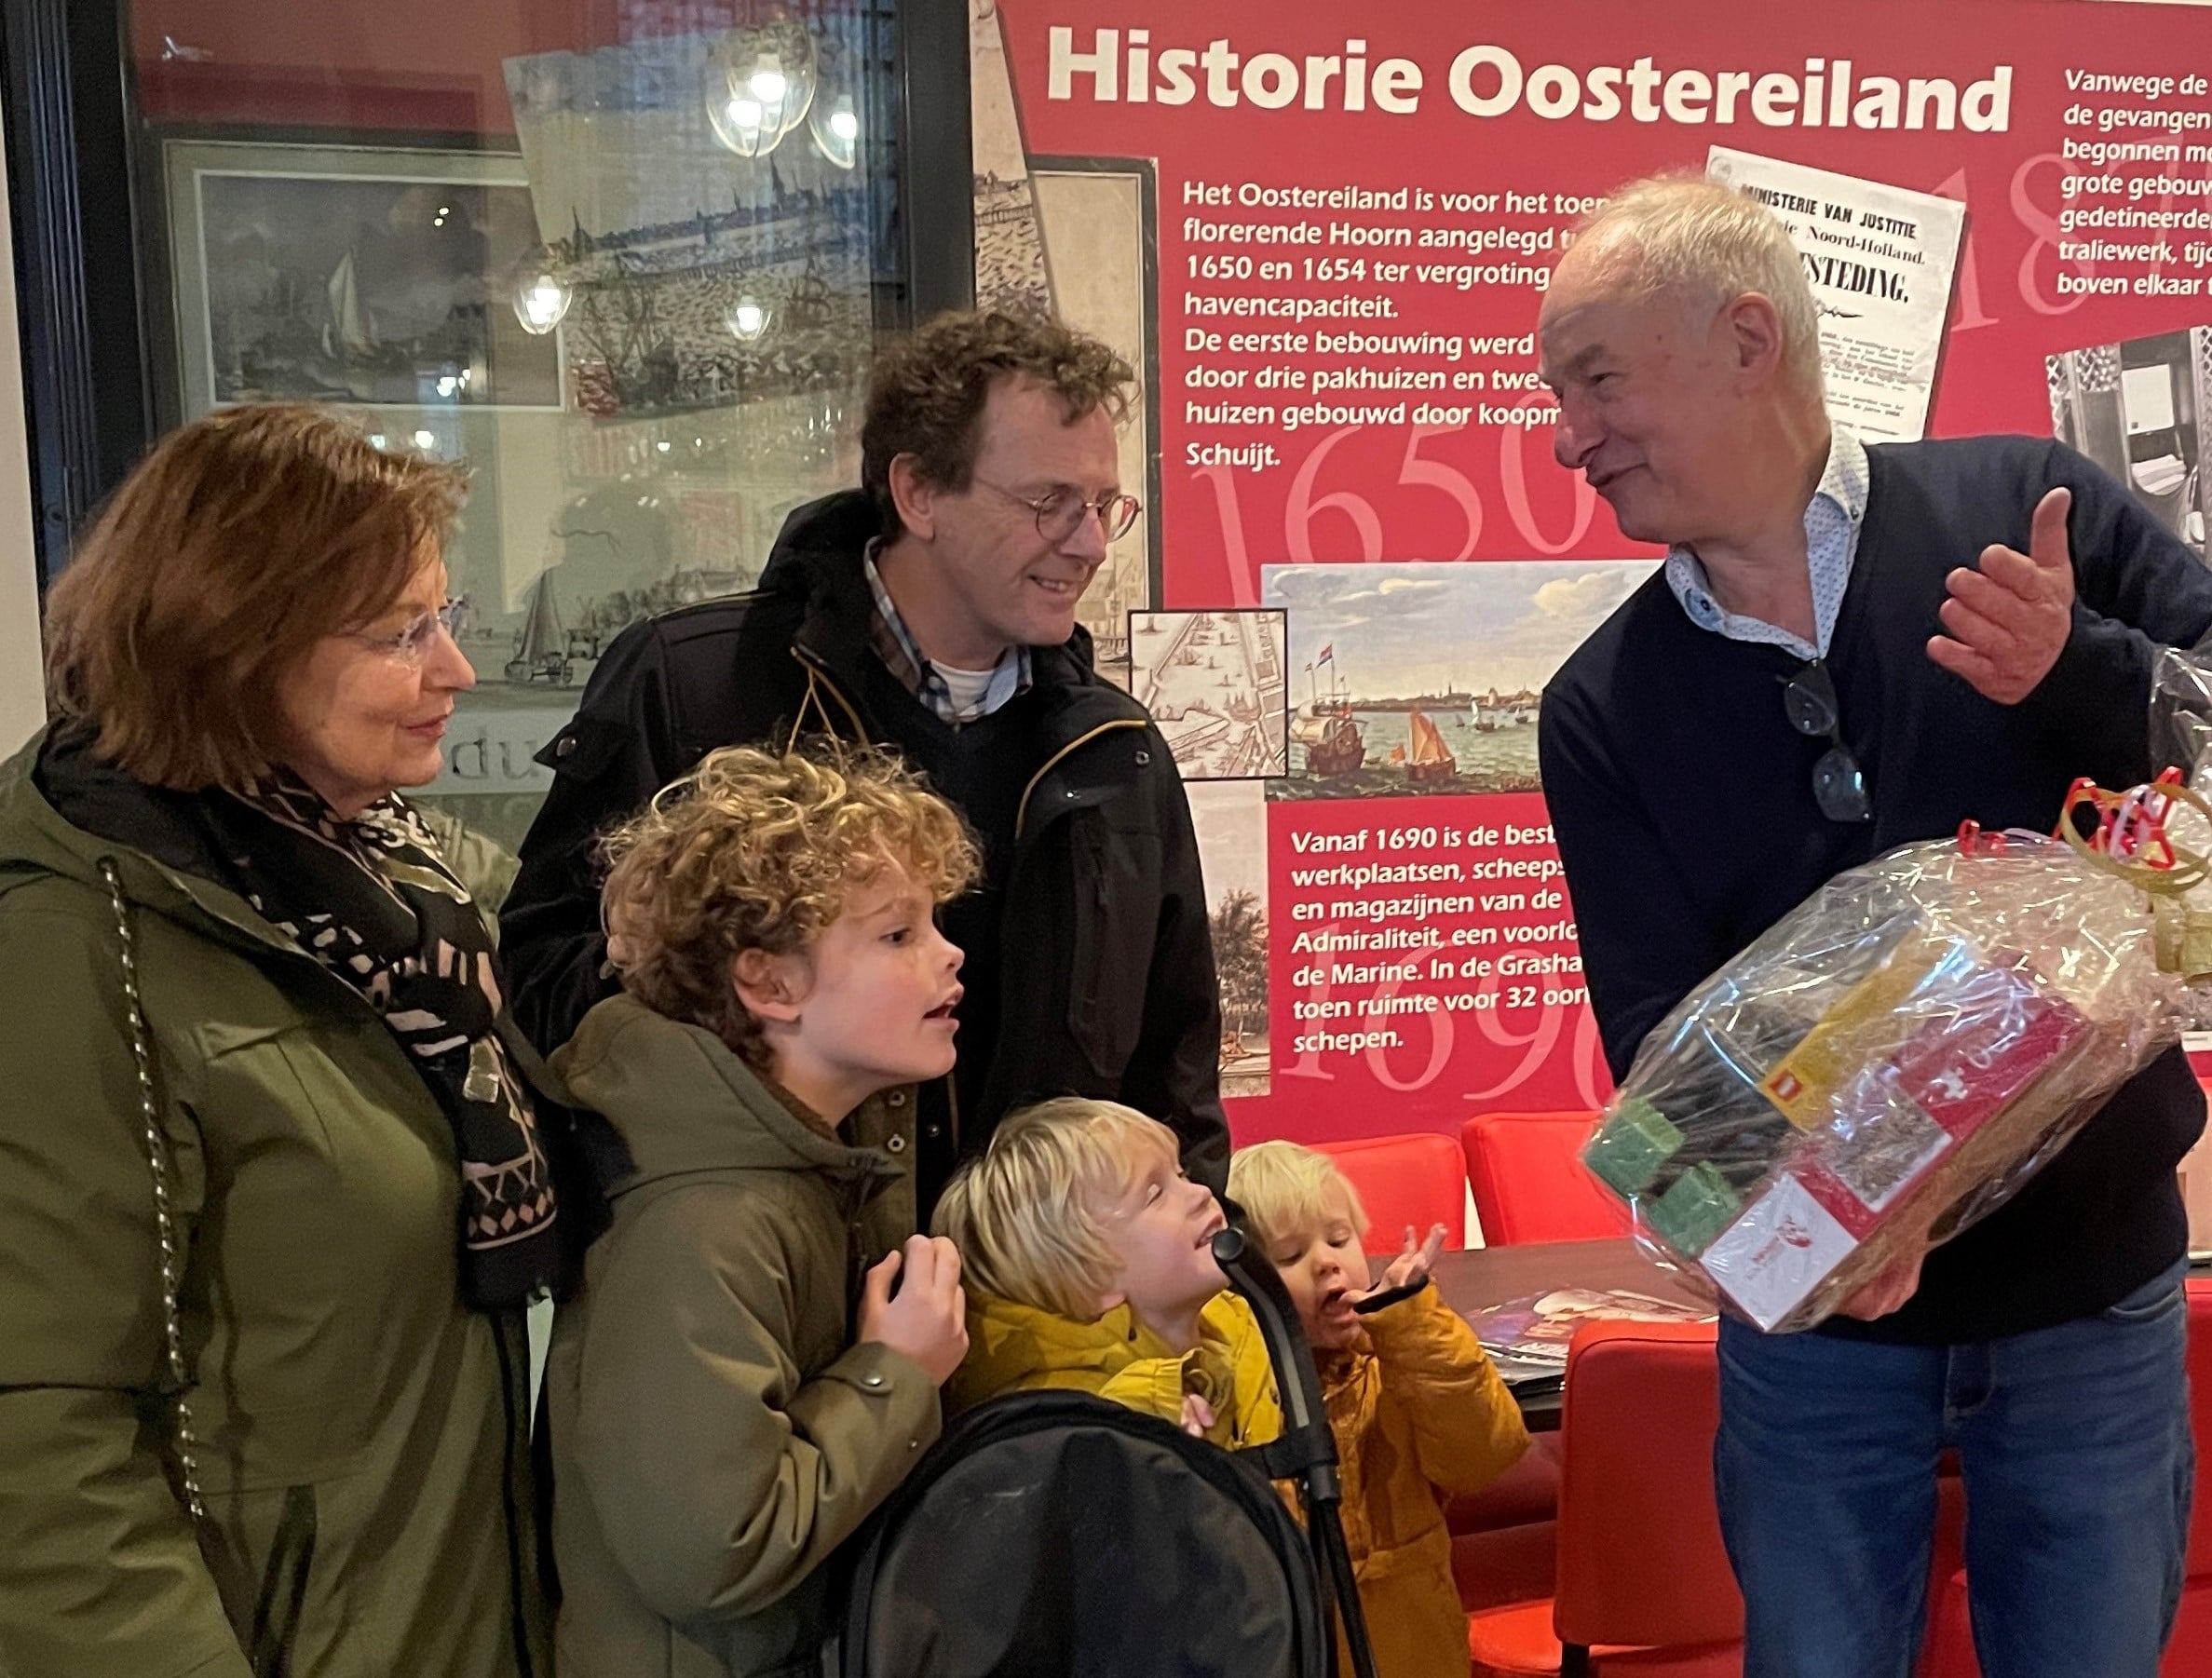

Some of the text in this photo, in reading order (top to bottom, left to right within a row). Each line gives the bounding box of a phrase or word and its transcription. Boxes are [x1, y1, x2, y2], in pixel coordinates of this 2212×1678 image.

[1048, 26, 2013, 132] Historie Oostereiland
[2065, 68, 2208, 100] Vanwege de
[2063, 103, 2094, 126] de
[2062, 137, 2180, 166] begonnen
[1183, 181, 1232, 206] Het
[1238, 183, 1408, 210] Oostereiland
[1415, 187, 1434, 211] is
[1440, 194, 1500, 212] voor
[1505, 190, 1549, 214] het
[2060, 173, 2124, 199] grote
[1825, 203, 1852, 223] VAN
[1859, 212, 1917, 239] JUSTITIE
[2059, 205, 2212, 233] gedetineerde
[1183, 217, 1323, 244] florerende
[1329, 222, 1412, 247] Hoorn
[1418, 225, 1554, 256] aangelegd
[2057, 238, 2178, 264] traliewerk,
[1187, 254, 1551, 291] 1650 en 1654 ter vergroting
[2056, 272, 2128, 294] boven
[2133, 273, 2204, 295] elkaar
[1185, 291, 1399, 323] havencapaciteit.
[1185, 328, 1534, 361] De eerste bebouwing werd
[1185, 364, 1249, 388] door
[1255, 365, 1307, 389] drie
[1311, 366, 1446, 396] pakhuizen
[1452, 372, 1485, 390] en
[1186, 400, 1275, 425] huizen
[1282, 401, 1405, 431] gebouwd
[1411, 402, 1472, 426] door
[1186, 442, 1281, 472] Schuijt.
[1291, 829, 1368, 853] Vanaf
[1377, 827, 1437, 850] 1690
[1444, 826, 1461, 847] is
[1467, 825, 1500, 846] de
[1291, 862, 1466, 890] werkplaatsen,
[1292, 888, 1562, 923] en magazijnen van de
[1291, 926, 1445, 954] Admiraliteit,
[1451, 927, 1498, 946] een
[1293, 965, 1325, 987] de
[1331, 961, 1424, 985] Marine.
[1431, 958, 1454, 980] In
[1459, 956, 1492, 978] de
[1293, 1000, 1351, 1020] toen
[1357, 994, 1439, 1016] ruimte
[1444, 992, 1500, 1011] voor
[1506, 986, 1537, 1008] 32
[1294, 1030, 1404, 1055] schepen.
